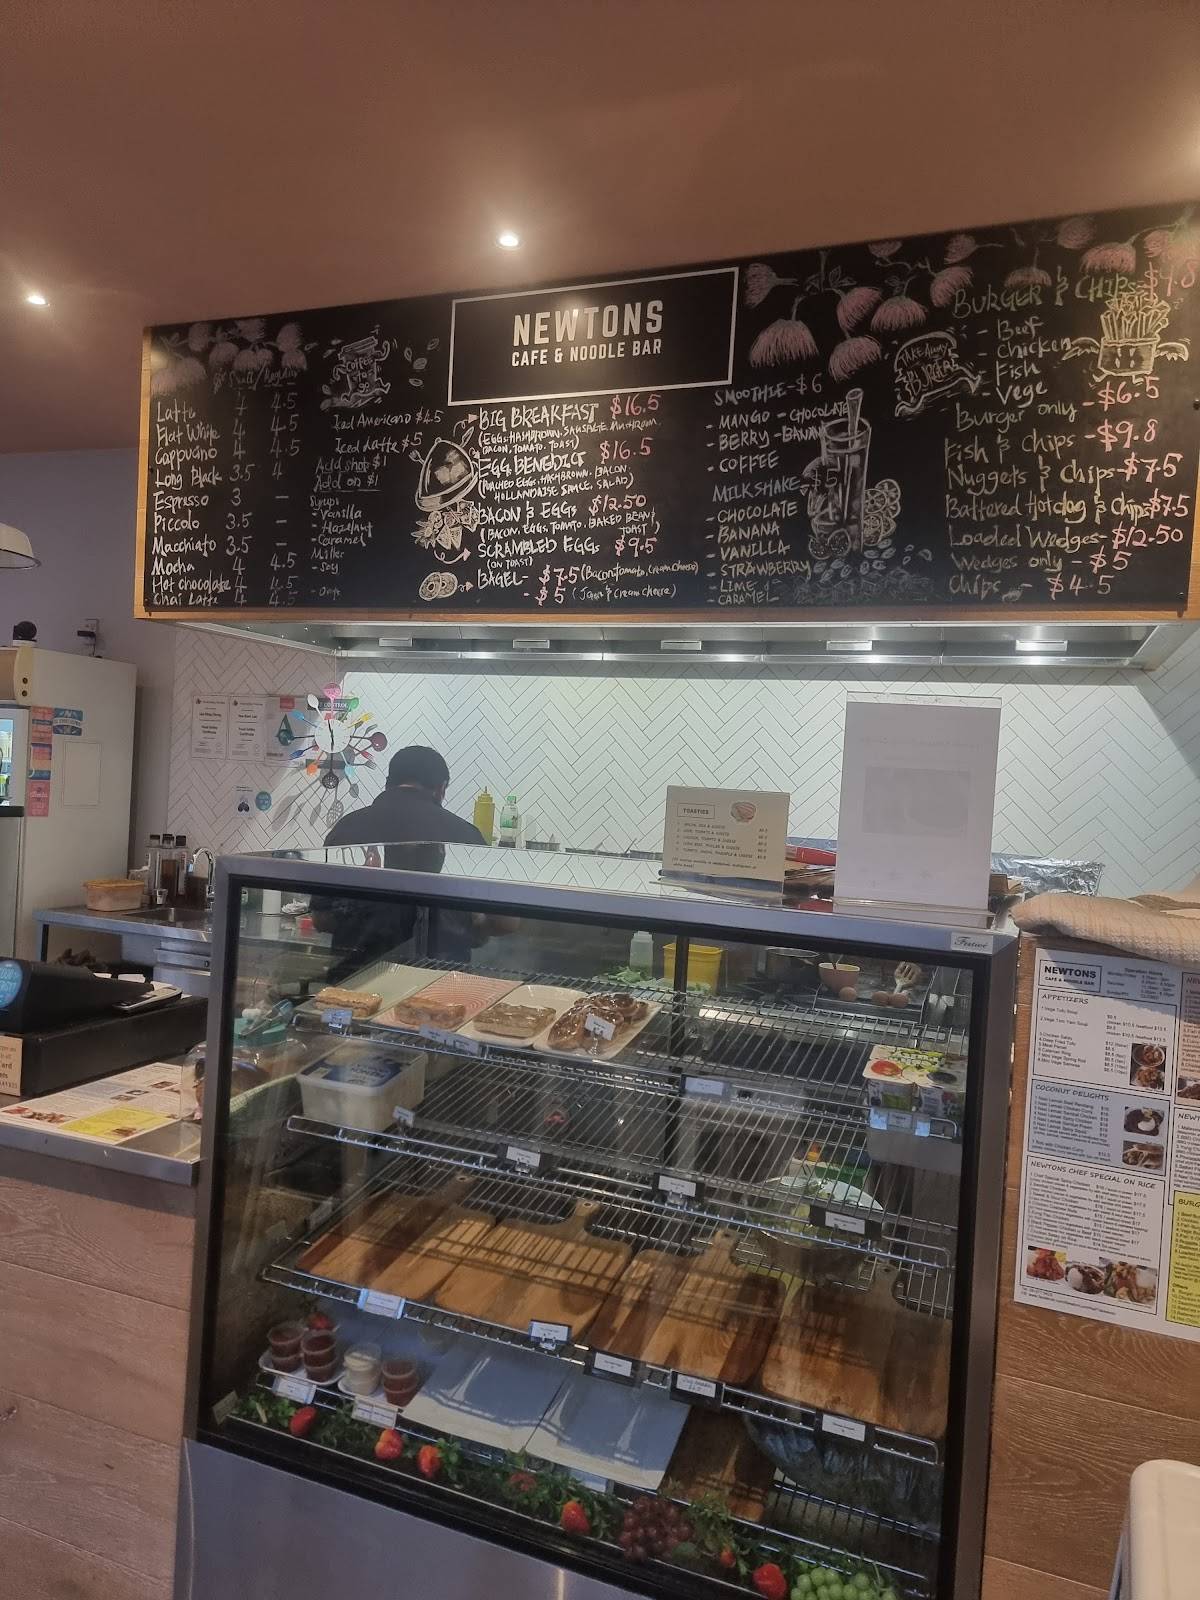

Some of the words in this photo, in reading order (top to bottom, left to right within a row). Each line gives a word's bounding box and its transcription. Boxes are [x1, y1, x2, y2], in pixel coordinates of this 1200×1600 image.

[952, 284, 1043, 319] BURGER
[512, 300, 664, 347] NEWTONS
[997, 315, 1044, 341] Beef
[511, 349, 548, 367] CAFE
[553, 347, 563, 363] &
[570, 341, 625, 363] NOODLE
[632, 338, 662, 356] BAR
[995, 360, 1041, 387] Fish
[955, 402, 1024, 434] Burger
[1037, 401, 1078, 423] only
[1097, 376, 1160, 411] $6.5
[996, 380, 1048, 408] Vege
[157, 398, 196, 423] Latte
[271, 391, 298, 412] 4.5
[357, 411, 412, 427] Americano
[415, 406, 443, 424] $4.5
[478, 405, 508, 432] BIG
[511, 402, 600, 428] BREAKFAST
[610, 393, 662, 420] $16.5
[718, 410, 770, 431] MANGO
[789, 400, 849, 424] CHOCOLATE
[156, 423, 183, 447] Flat
[186, 421, 221, 447] White
[270, 414, 299, 436] 4.5
[718, 429, 770, 451] BERRY
[944, 435, 989, 465] Fish
[1096, 418, 1159, 452] $9.8
[233, 440, 246, 459] 4
[270, 437, 300, 459] 4.5
[335, 437, 360, 454] Iced
[363, 435, 400, 454] Latte
[401, 432, 423, 453] $5
[315, 457, 342, 473] Add
[372, 453, 387, 469] $1
[514, 451, 587, 477] BENEDICT
[600, 437, 653, 464] $16.5
[719, 450, 780, 474] COFFEE
[155, 468, 183, 490] Long
[191, 464, 222, 488] Black
[229, 463, 255, 481] 3.5
[313, 474, 342, 492] Add
[346, 478, 361, 487] on
[367, 472, 379, 487] $1
[947, 463, 1028, 496] Nuggets
[153, 490, 209, 514] Espresso
[231, 488, 242, 506] 3
[494, 485, 559, 502] HOLLANDAISE
[320, 504, 362, 520] Vanilla
[478, 502, 522, 526] BACON
[588, 494, 647, 516] $12.50
[716, 499, 798, 524] CHOCOLATE
[946, 491, 1022, 522] Battered
[1025, 491, 1087, 524] Hotdog
[154, 509, 200, 534] Piccolo
[225, 512, 253, 530] 3.5
[321, 520, 373, 538] Hazelnut
[588, 514, 622, 530] BAKED
[625, 510, 650, 524] BEAN
[318, 533, 366, 547] Caramel
[717, 521, 780, 544] BANANA
[948, 523, 1022, 548] Loaded
[1111, 520, 1184, 550] $12.50
[151, 533, 217, 558] Macchiato
[225, 535, 253, 556] 3.5
[477, 536, 558, 559] SCRAMBLED
[614, 535, 658, 557] $9.5
[720, 539, 791, 562] VANILLA
[151, 556, 195, 576] Mocha
[232, 556, 246, 576] 4
[270, 552, 297, 571] 4.5
[320, 562, 338, 574] Soy
[487, 558, 504, 570] (ON
[505, 555, 534, 570] TOAST)
[720, 560, 812, 581] STRAWBERRY
[951, 553, 1018, 573] Wedges
[1028, 550, 1063, 573] only
[1089, 545, 1133, 574] $5
[152, 575, 175, 594] Hot
[178, 570, 232, 594] chocolate
[234, 575, 247, 593] 4
[538, 564, 580, 587] $7.5
[720, 579, 760, 593] LIME
[949, 573, 1002, 600] Chips
[1046, 573, 1116, 600] $4.5
[153, 593, 182, 606] Chai
[189, 592, 218, 606] Latte
[534, 586, 567, 607] $5
[718, 588, 780, 606] CARAMEL
[1044, 965, 1097, 979] NEWTONS
[1041, 993, 1089, 1005] APPETIZERS
[1035, 1084, 1071, 1096] COCONUT
[1072, 1090, 1110, 1101] DELIGHTS
[1030, 1161, 1067, 1173] NEWTONS
[1068, 1167, 1087, 1176] CHEF
[1089, 1172, 1121, 1183] SPECIAL
[1123, 1178, 1136, 1186] ON
[1137, 1181, 1157, 1189] RICE
